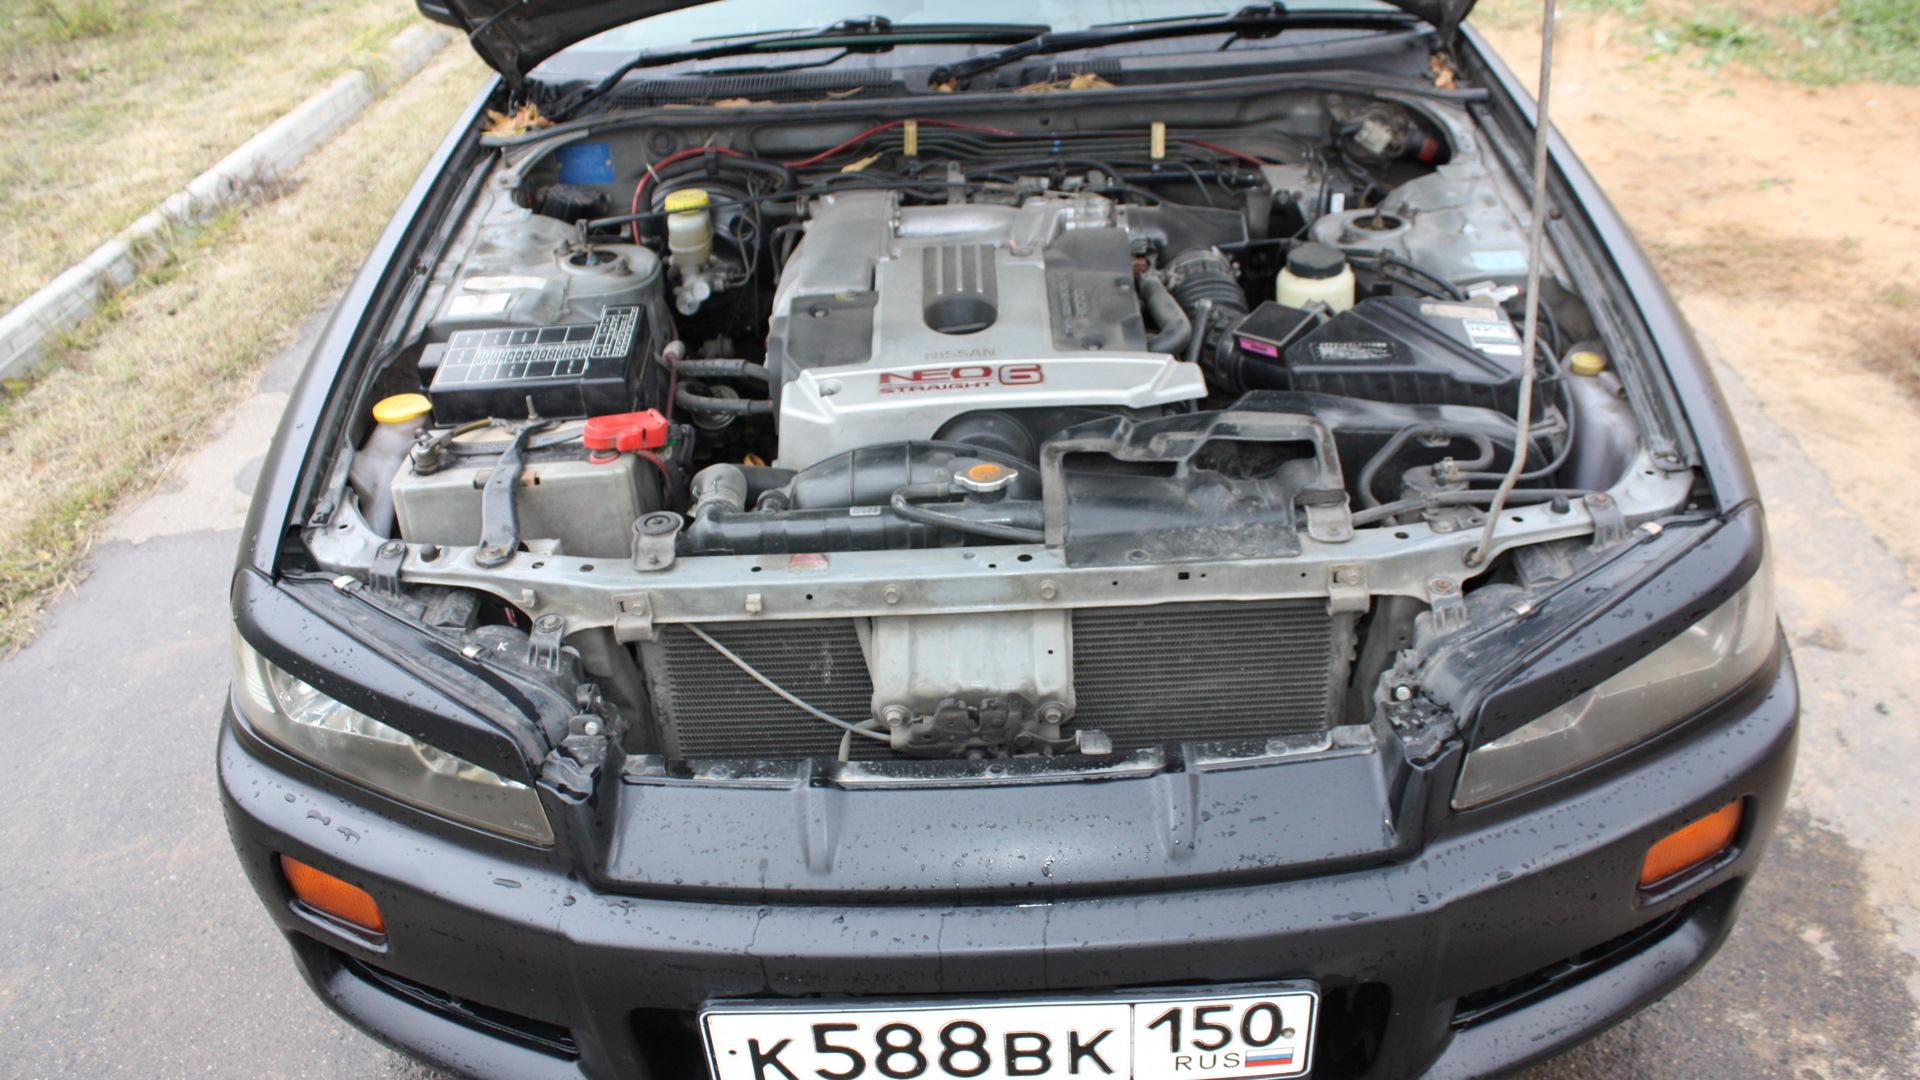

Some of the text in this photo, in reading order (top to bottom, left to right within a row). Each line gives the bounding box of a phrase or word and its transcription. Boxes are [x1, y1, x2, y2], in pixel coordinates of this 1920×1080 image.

[925, 347, 995, 360] NISSAN
[880, 363, 1044, 386] NEO 6
[879, 382, 991, 394] STRAIGHT
[1145, 1001, 1283, 1053] 150
[1175, 1052, 1240, 1071] RUS
